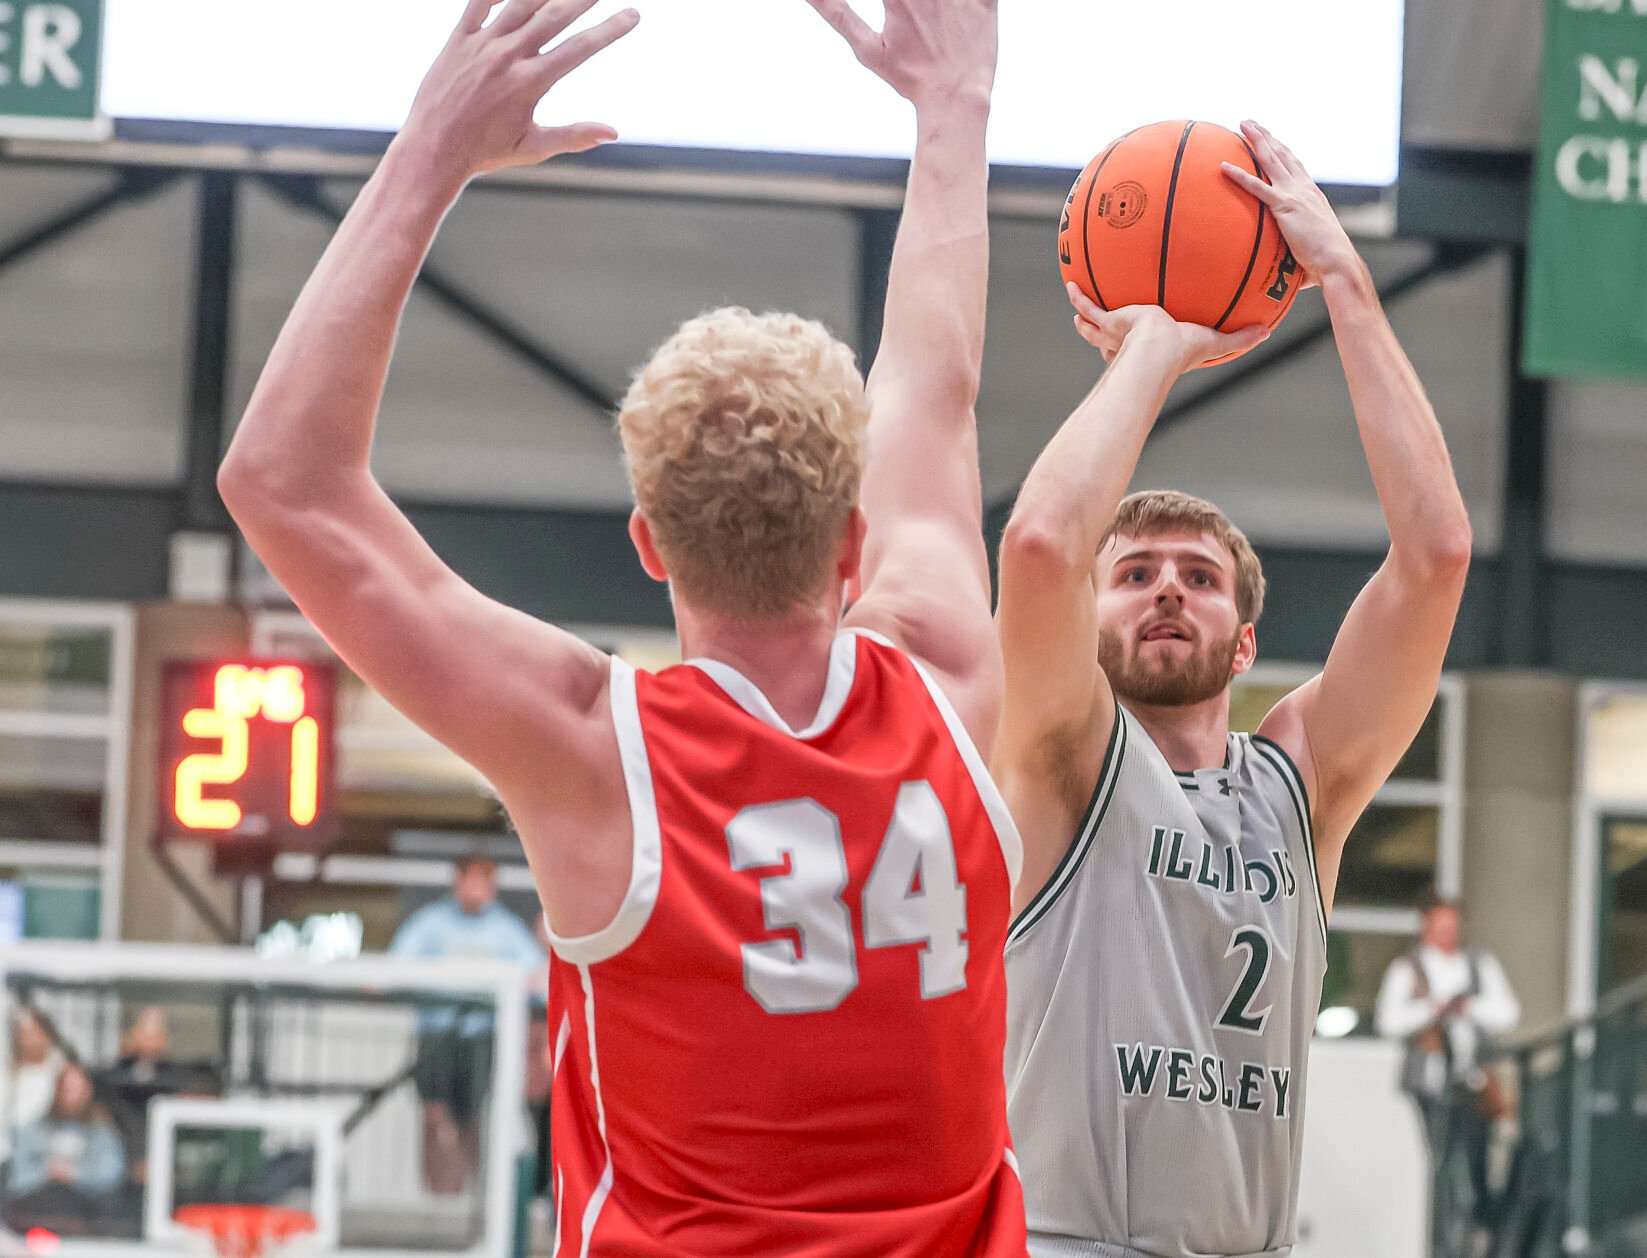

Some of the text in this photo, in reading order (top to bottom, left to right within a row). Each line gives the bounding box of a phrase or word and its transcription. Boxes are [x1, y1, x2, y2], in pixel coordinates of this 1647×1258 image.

[0, 2, 83, 88] R
[175, 708, 319, 829] 21
[724, 779, 969, 1014] 34
[1212, 924, 1274, 1036] 2
[1112, 1041, 1292, 1119] WESLEY
